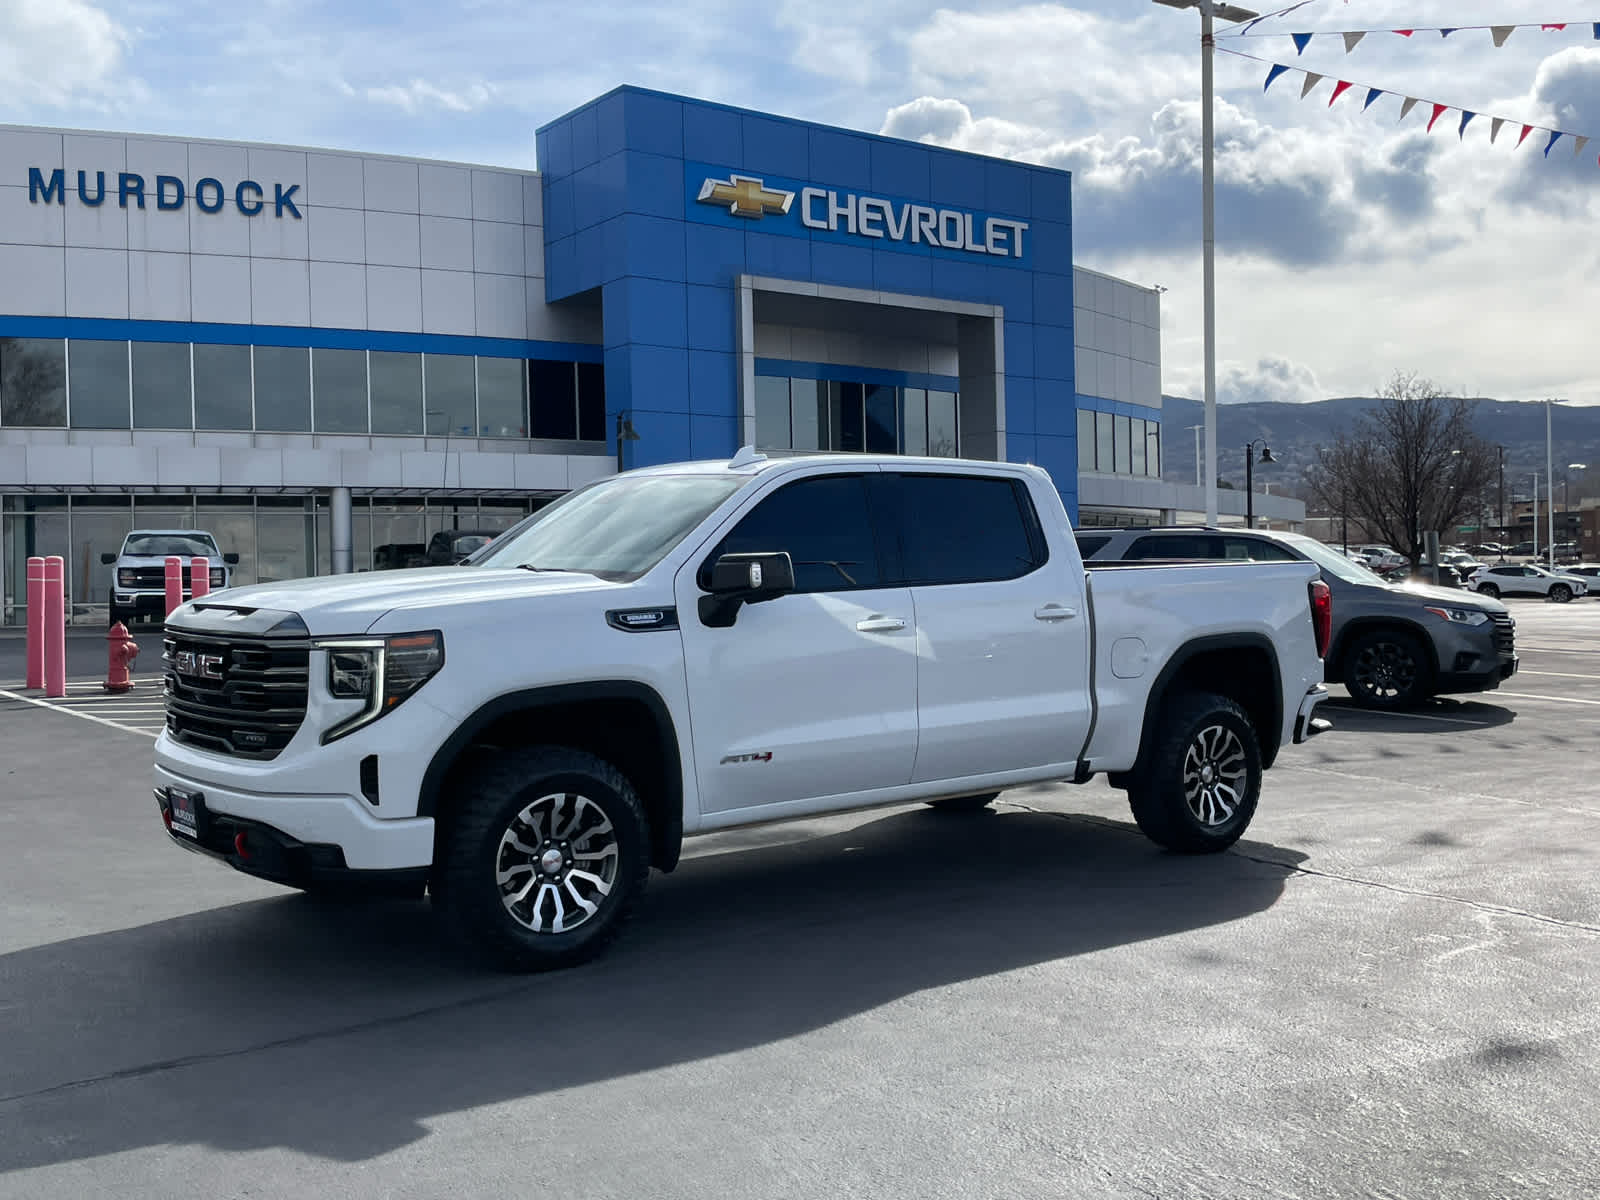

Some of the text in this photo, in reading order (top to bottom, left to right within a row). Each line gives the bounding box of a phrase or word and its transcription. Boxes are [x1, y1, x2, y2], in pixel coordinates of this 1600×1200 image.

[28, 167, 302, 219] MURDOCK
[802, 187, 1029, 257] CHEVROLET
[175, 651, 224, 680] GMC
